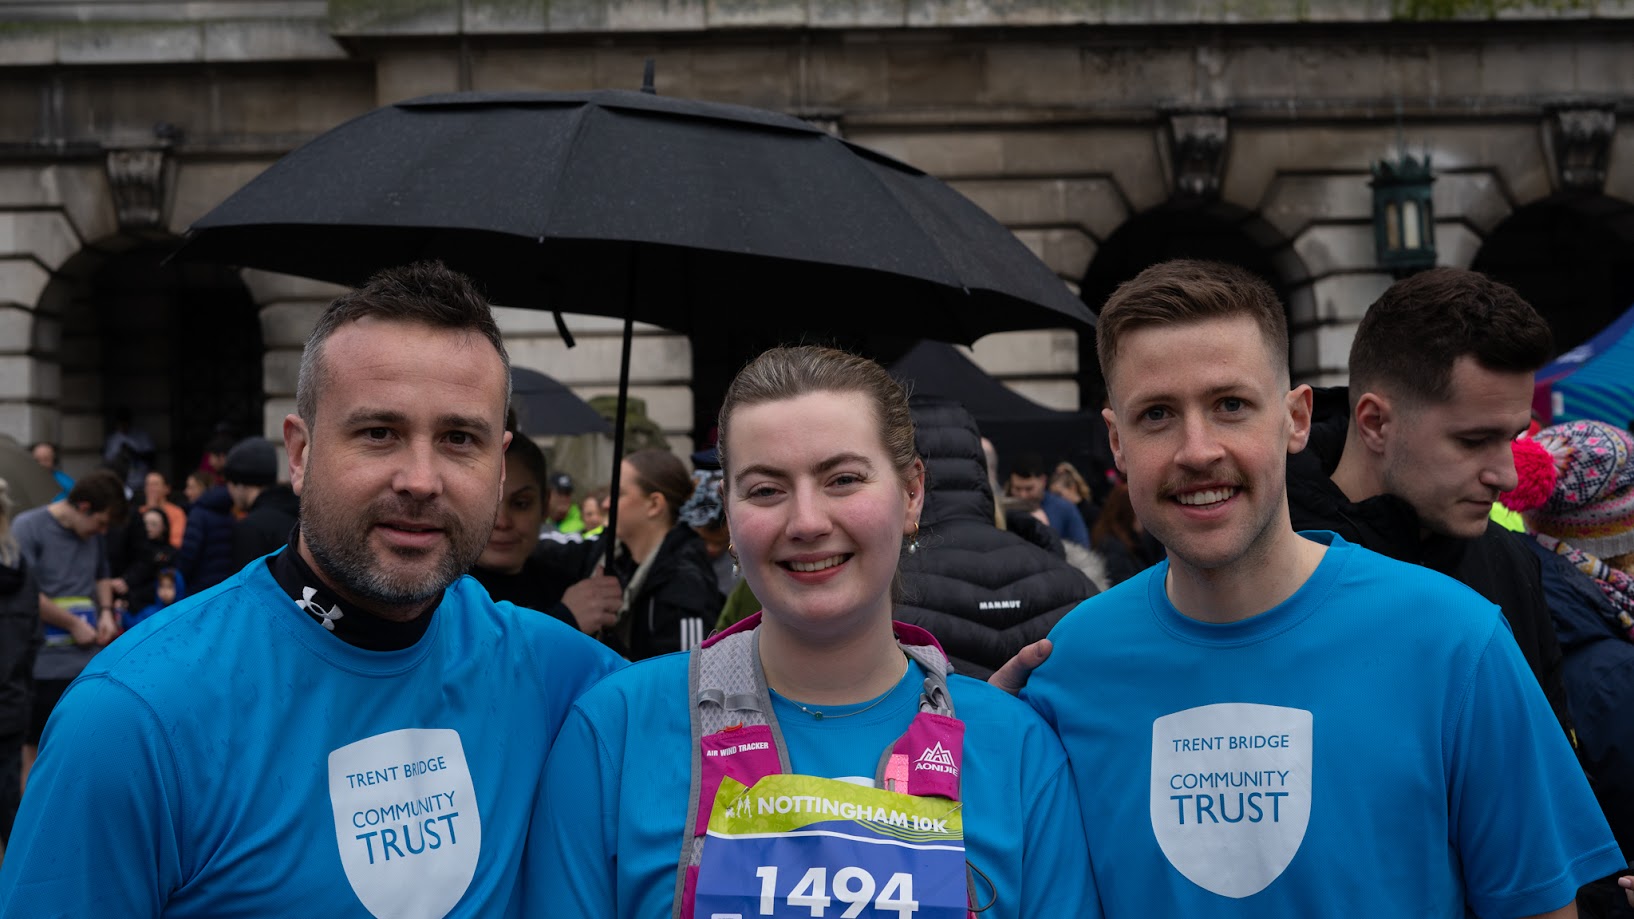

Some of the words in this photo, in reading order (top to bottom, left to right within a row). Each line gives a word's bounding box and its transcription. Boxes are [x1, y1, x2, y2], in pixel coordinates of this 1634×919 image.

[979, 600, 1021, 610] MAMMUT
[720, 746, 737, 757] WIND
[738, 742, 769, 752] TRACKER
[1172, 737, 1224, 752] TRENT
[1229, 735, 1289, 749] BRIDGE
[346, 766, 399, 789] TRENT
[403, 756, 447, 778] BRIDGE
[914, 762, 959, 777] AONIJIE
[1169, 770, 1289, 790] COMMUNITY
[352, 790, 455, 828] COMMUNITY
[757, 795, 908, 829] NOTTINGHAM
[911, 814, 949, 834] 10K
[1169, 792, 1289, 825] TRUST
[355, 811, 459, 865] TRUST
[756, 866, 919, 919] 1494
